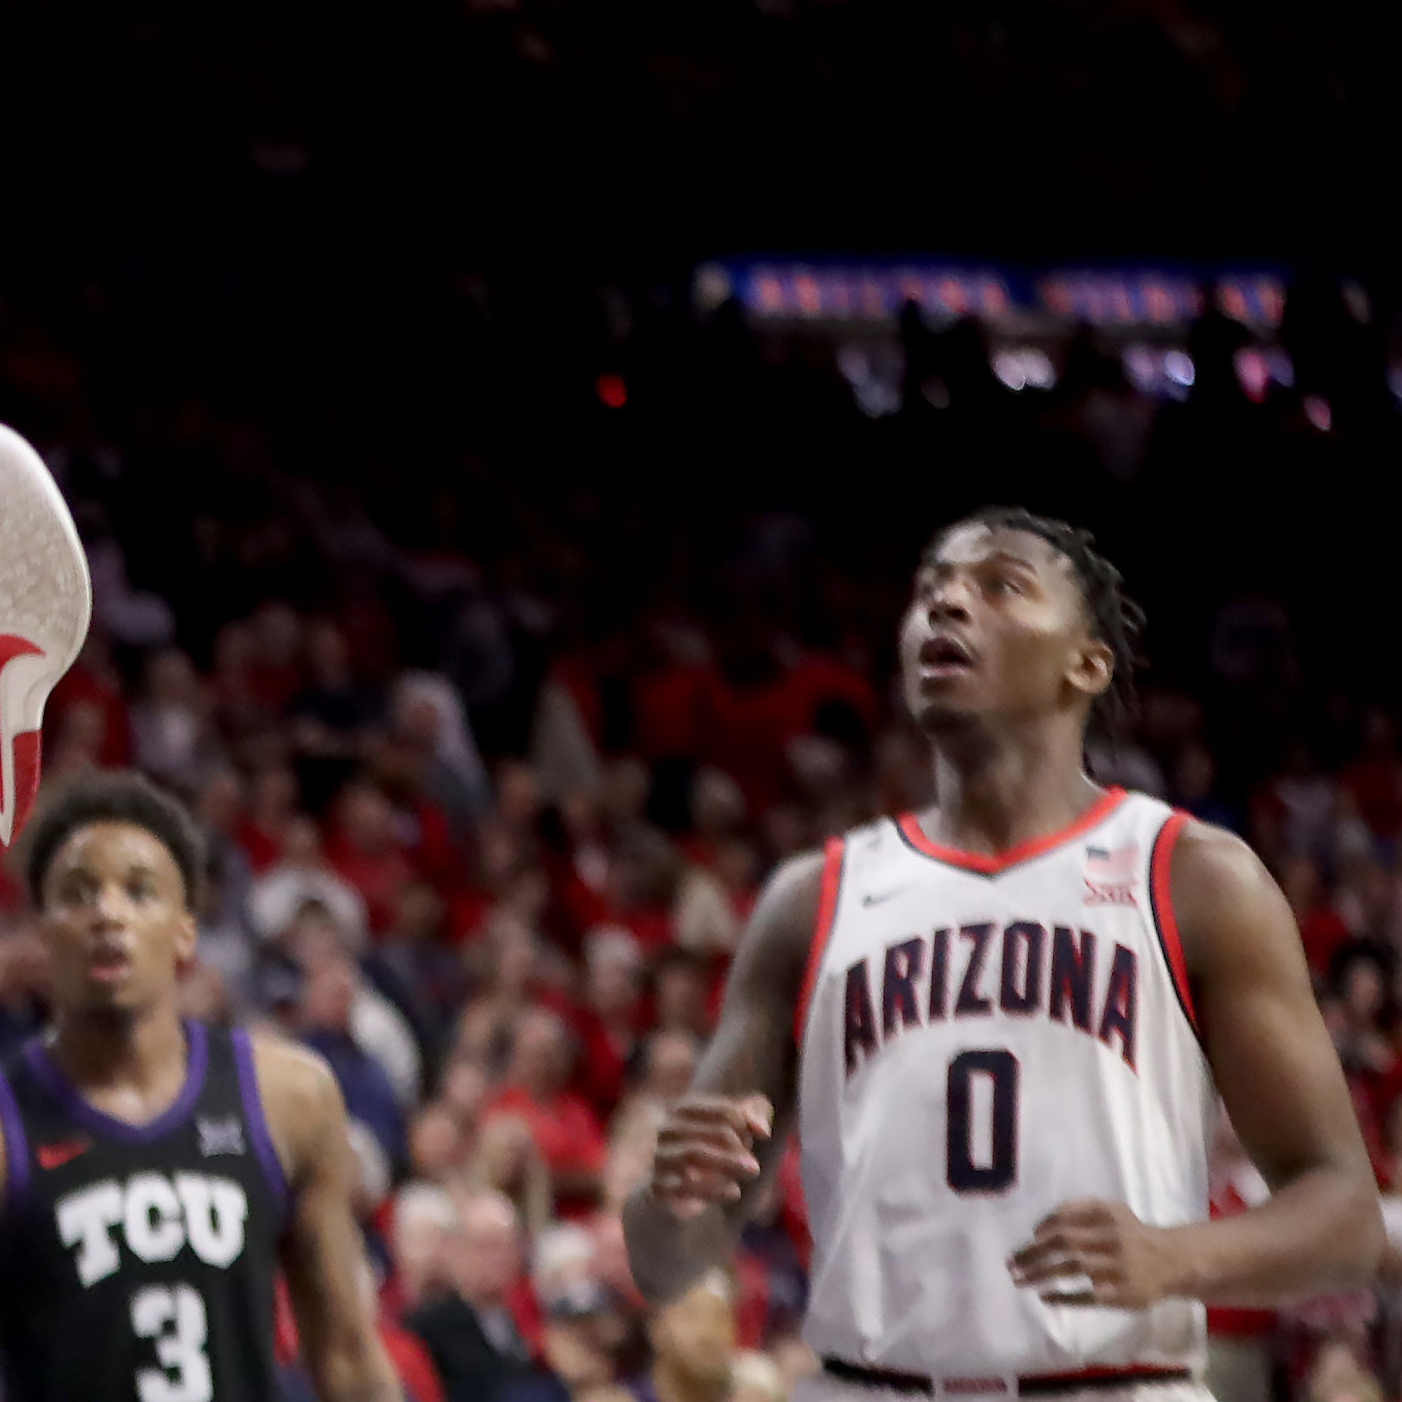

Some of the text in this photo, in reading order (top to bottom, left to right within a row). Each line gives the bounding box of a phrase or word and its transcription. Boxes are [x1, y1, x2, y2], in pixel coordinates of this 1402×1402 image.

[843, 920, 1140, 1082] ARIZONA
[946, 1048, 1021, 1195] 0
[55, 1171, 249, 1289] TCU
[130, 1282, 214, 1402] 3
